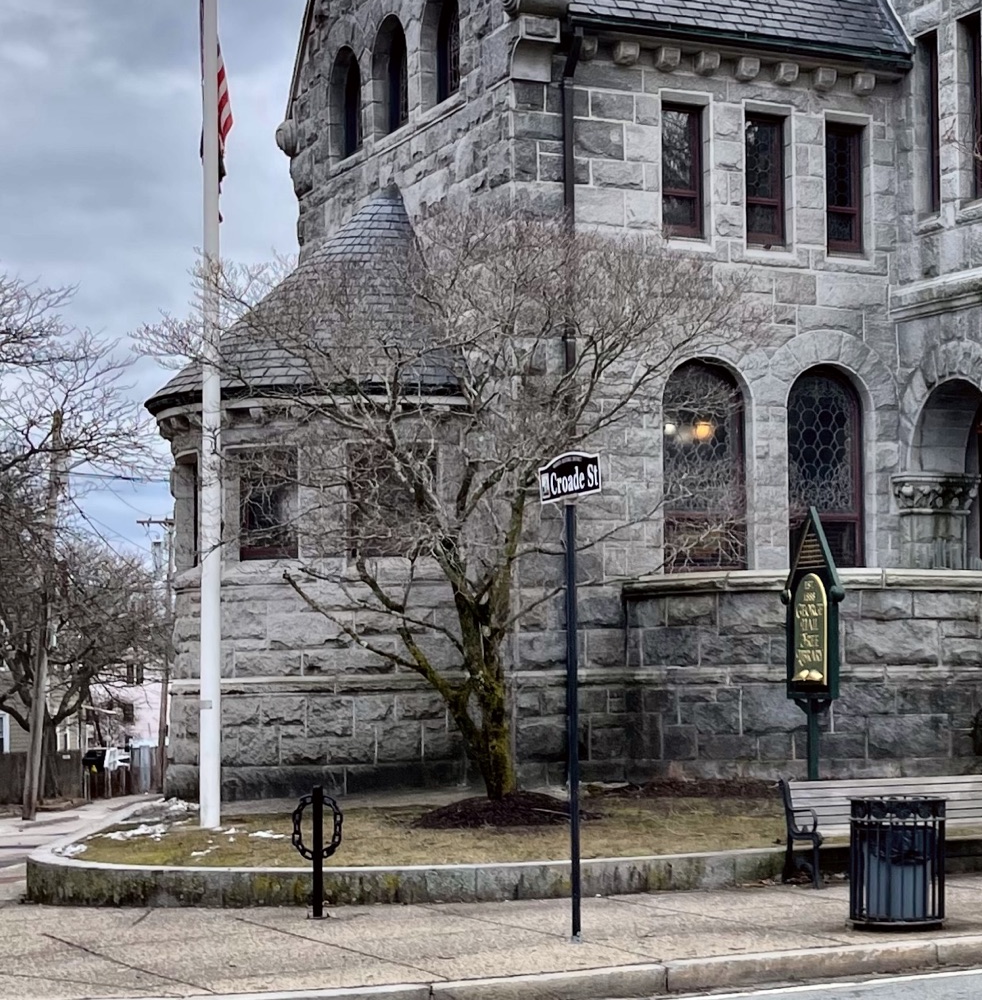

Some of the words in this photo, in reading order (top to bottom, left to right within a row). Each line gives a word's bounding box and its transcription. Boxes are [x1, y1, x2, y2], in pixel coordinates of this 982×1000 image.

[550, 465, 585, 496] Croade
[587, 463, 598, 488] St
[795, 603, 824, 619] GEORGE
[800, 632, 820, 648] FREE
[795, 649, 823, 667] LIBRARY
